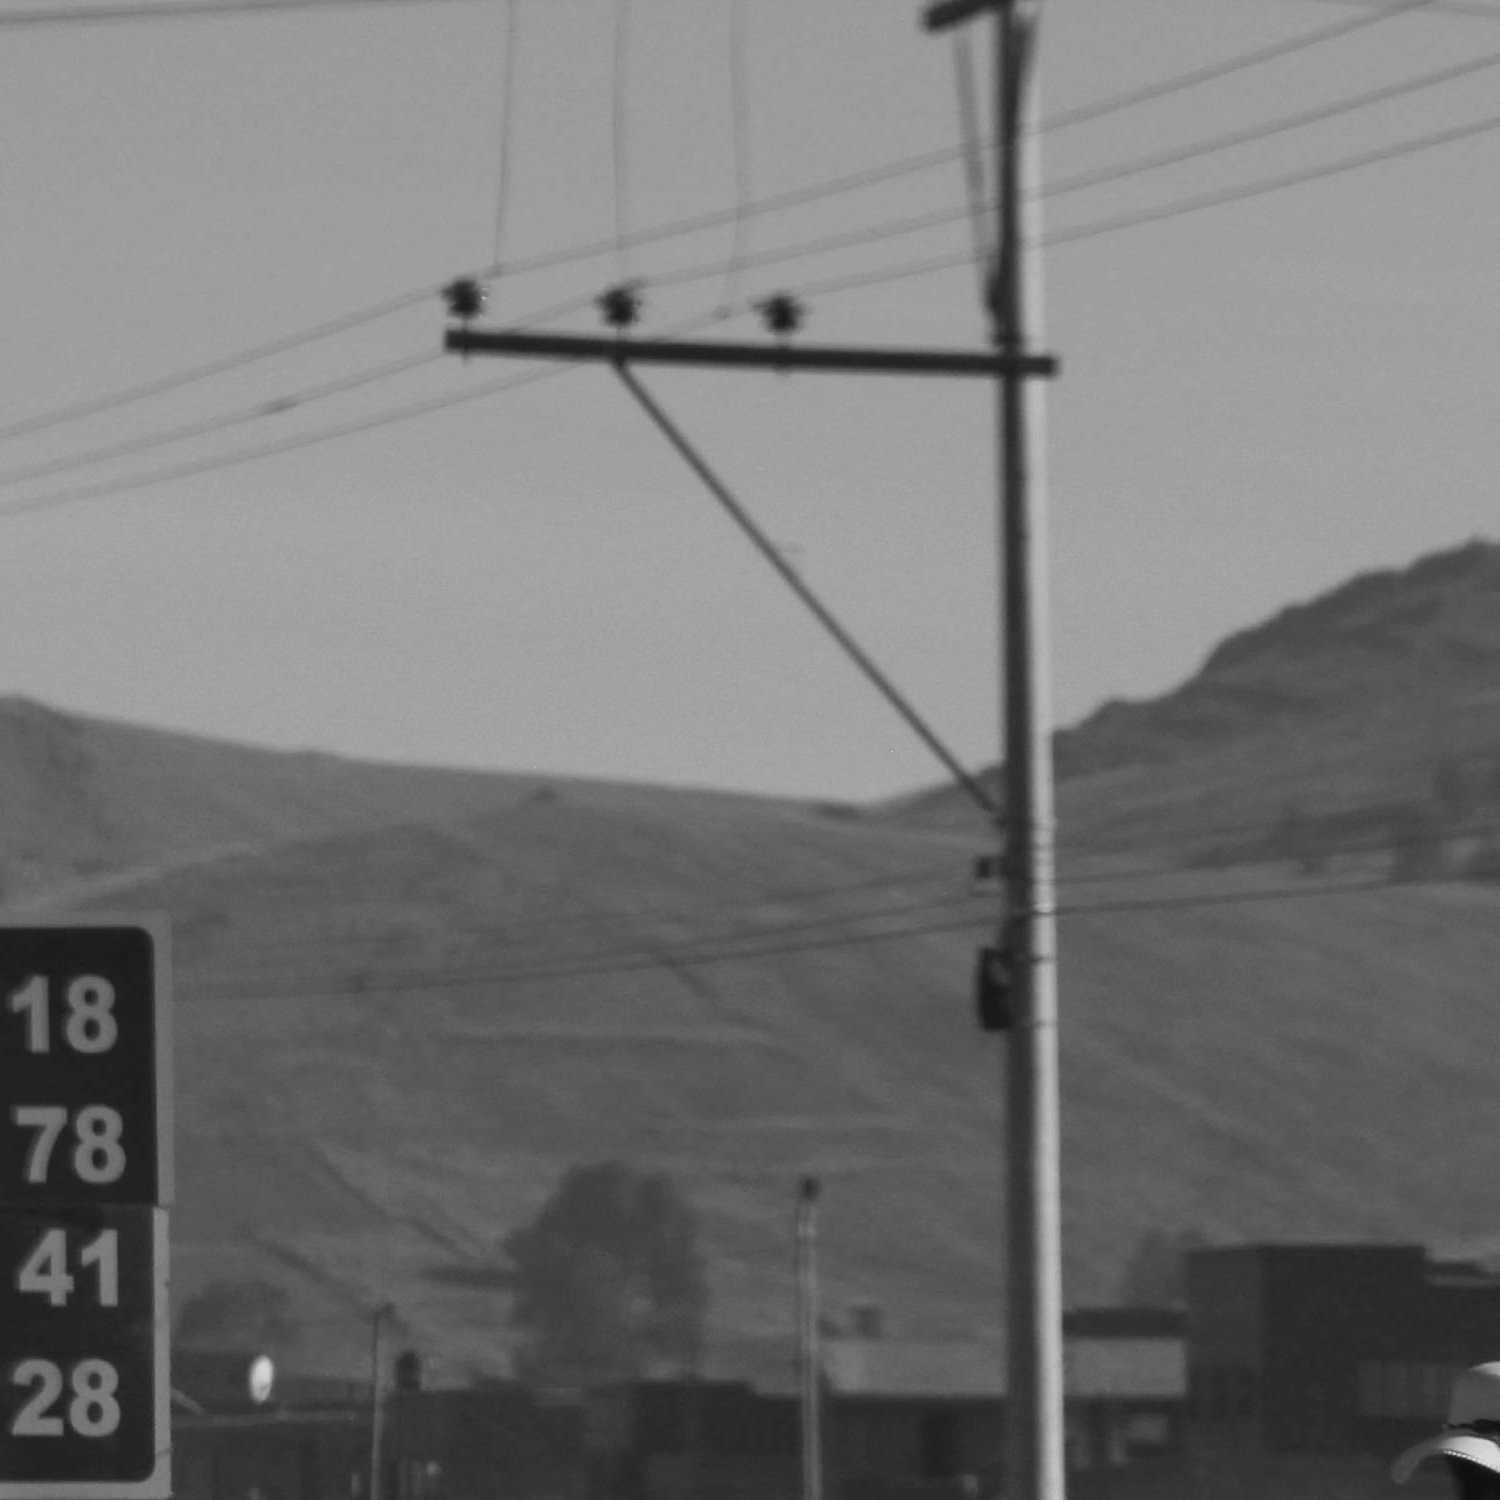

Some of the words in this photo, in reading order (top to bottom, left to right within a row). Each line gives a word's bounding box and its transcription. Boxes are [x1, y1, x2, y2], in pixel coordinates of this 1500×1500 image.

[11, 1105, 127, 1184] 78
[18, 1228, 119, 1307] 41
[10, 1358, 122, 1437] 28
